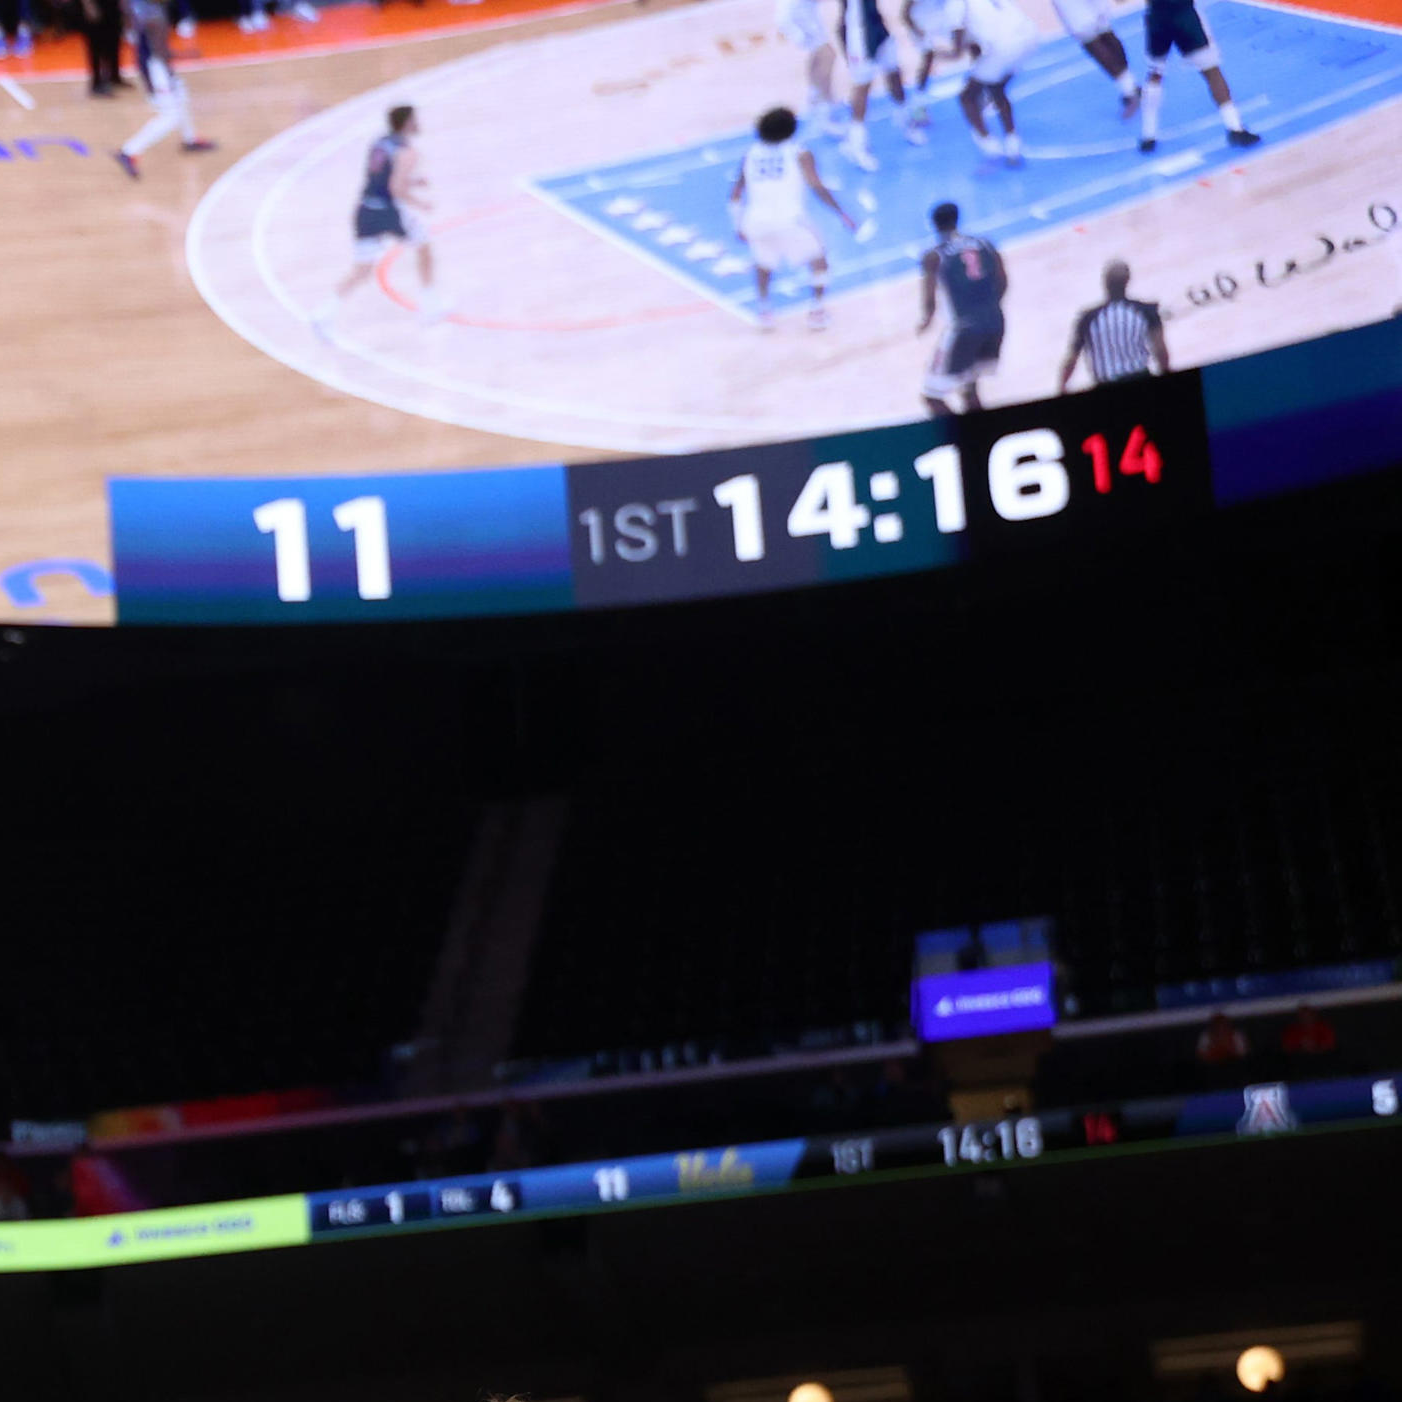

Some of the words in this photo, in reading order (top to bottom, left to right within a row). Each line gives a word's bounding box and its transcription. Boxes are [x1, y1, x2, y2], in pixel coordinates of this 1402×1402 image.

[253, 495, 391, 602] 11
[580, 498, 697, 565] 1ST
[712, 427, 1070, 563] 14:16
[1081, 424, 1164, 494] 14
